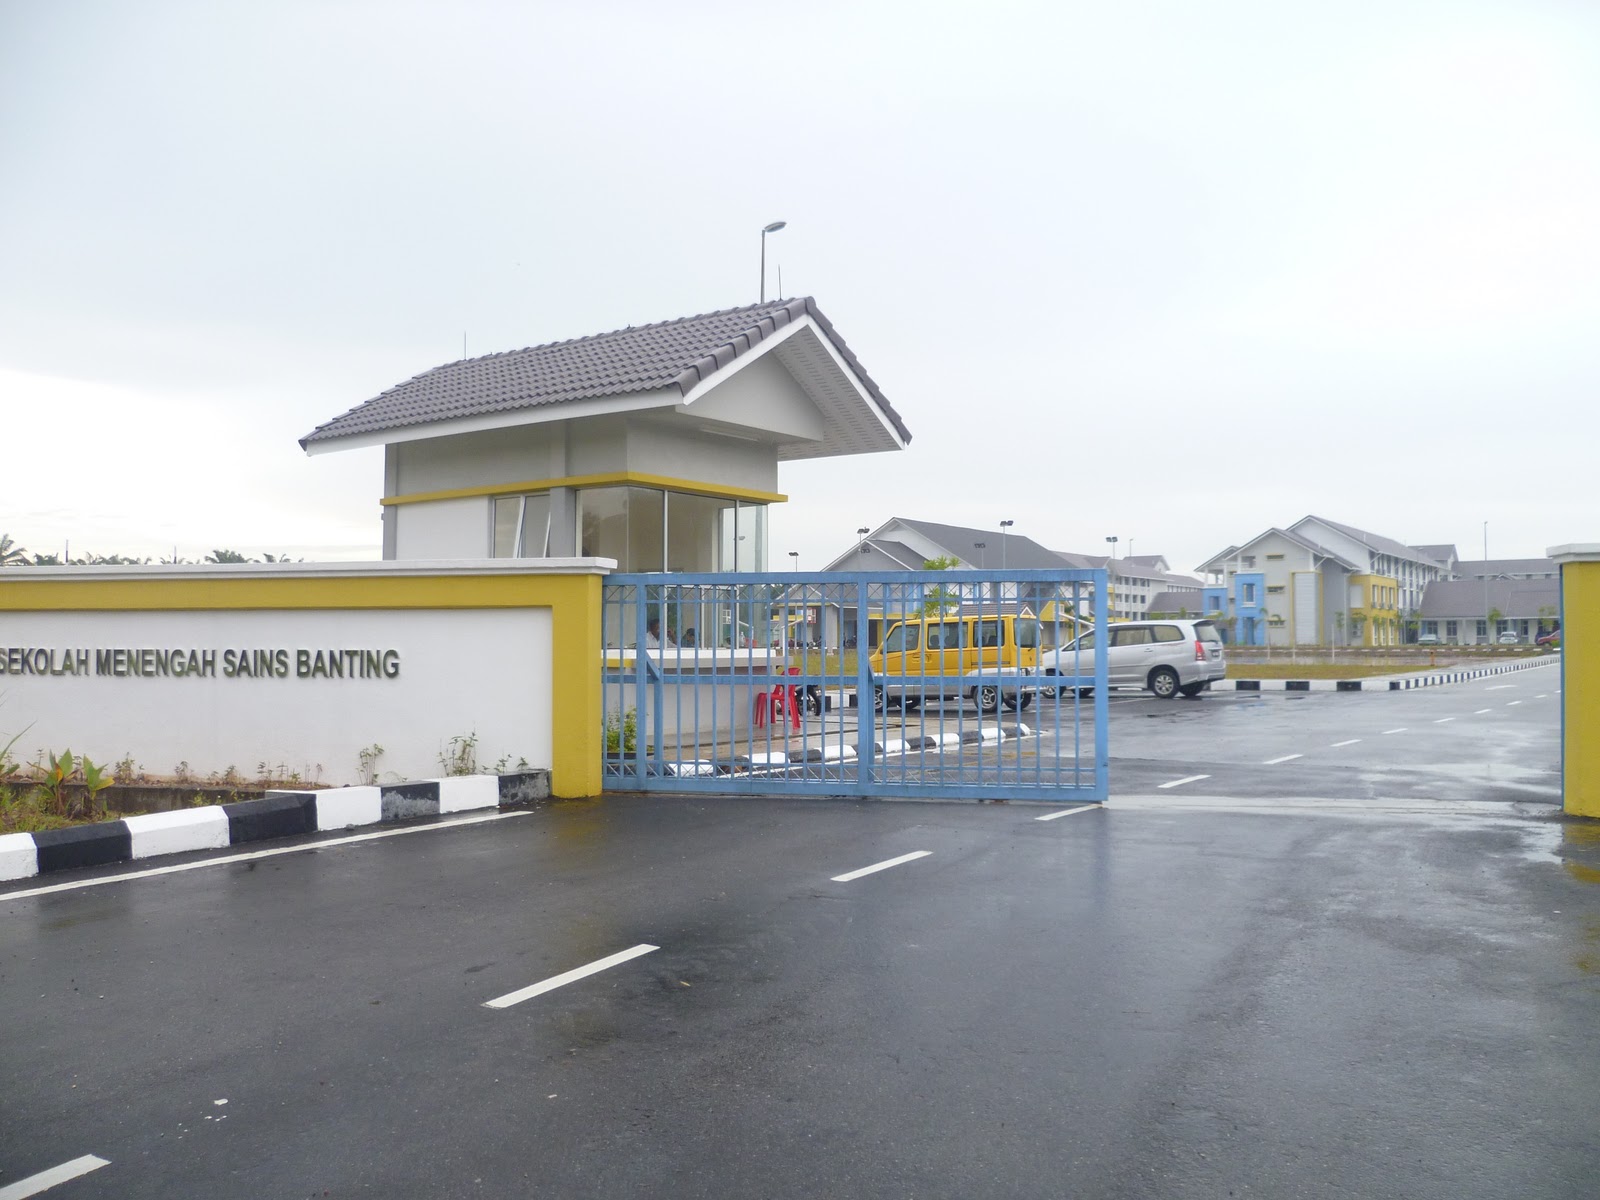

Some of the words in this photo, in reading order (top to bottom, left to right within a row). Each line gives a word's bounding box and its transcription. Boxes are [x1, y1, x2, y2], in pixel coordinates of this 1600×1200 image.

[96, 648, 216, 677] MENENGAH
[223, 648, 289, 678] SAINS
[297, 649, 400, 679] BANTING
